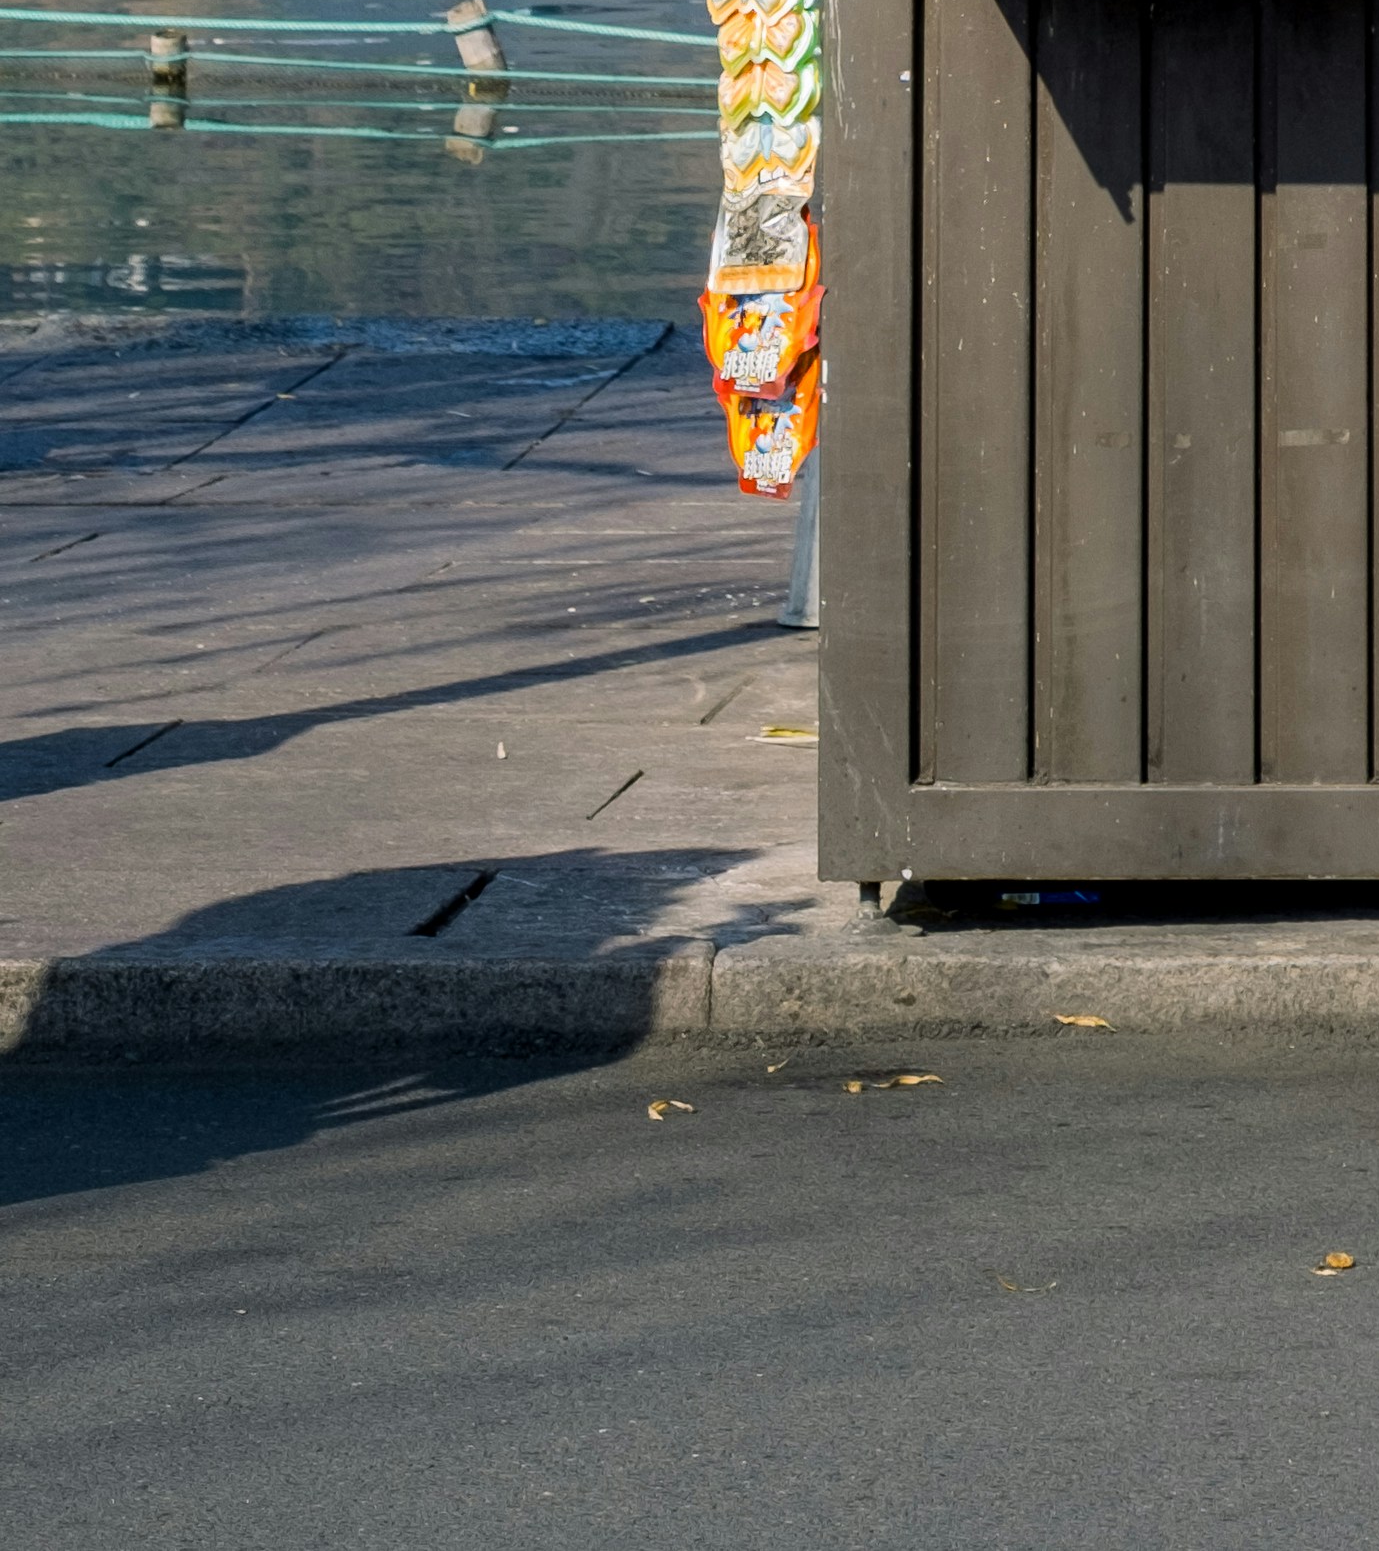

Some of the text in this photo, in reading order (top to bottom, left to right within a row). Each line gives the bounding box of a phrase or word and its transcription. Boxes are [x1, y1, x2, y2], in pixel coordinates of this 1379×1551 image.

[720, 347, 780, 383] 跳跳糖
[743, 449, 793, 484] 跳跳糖
